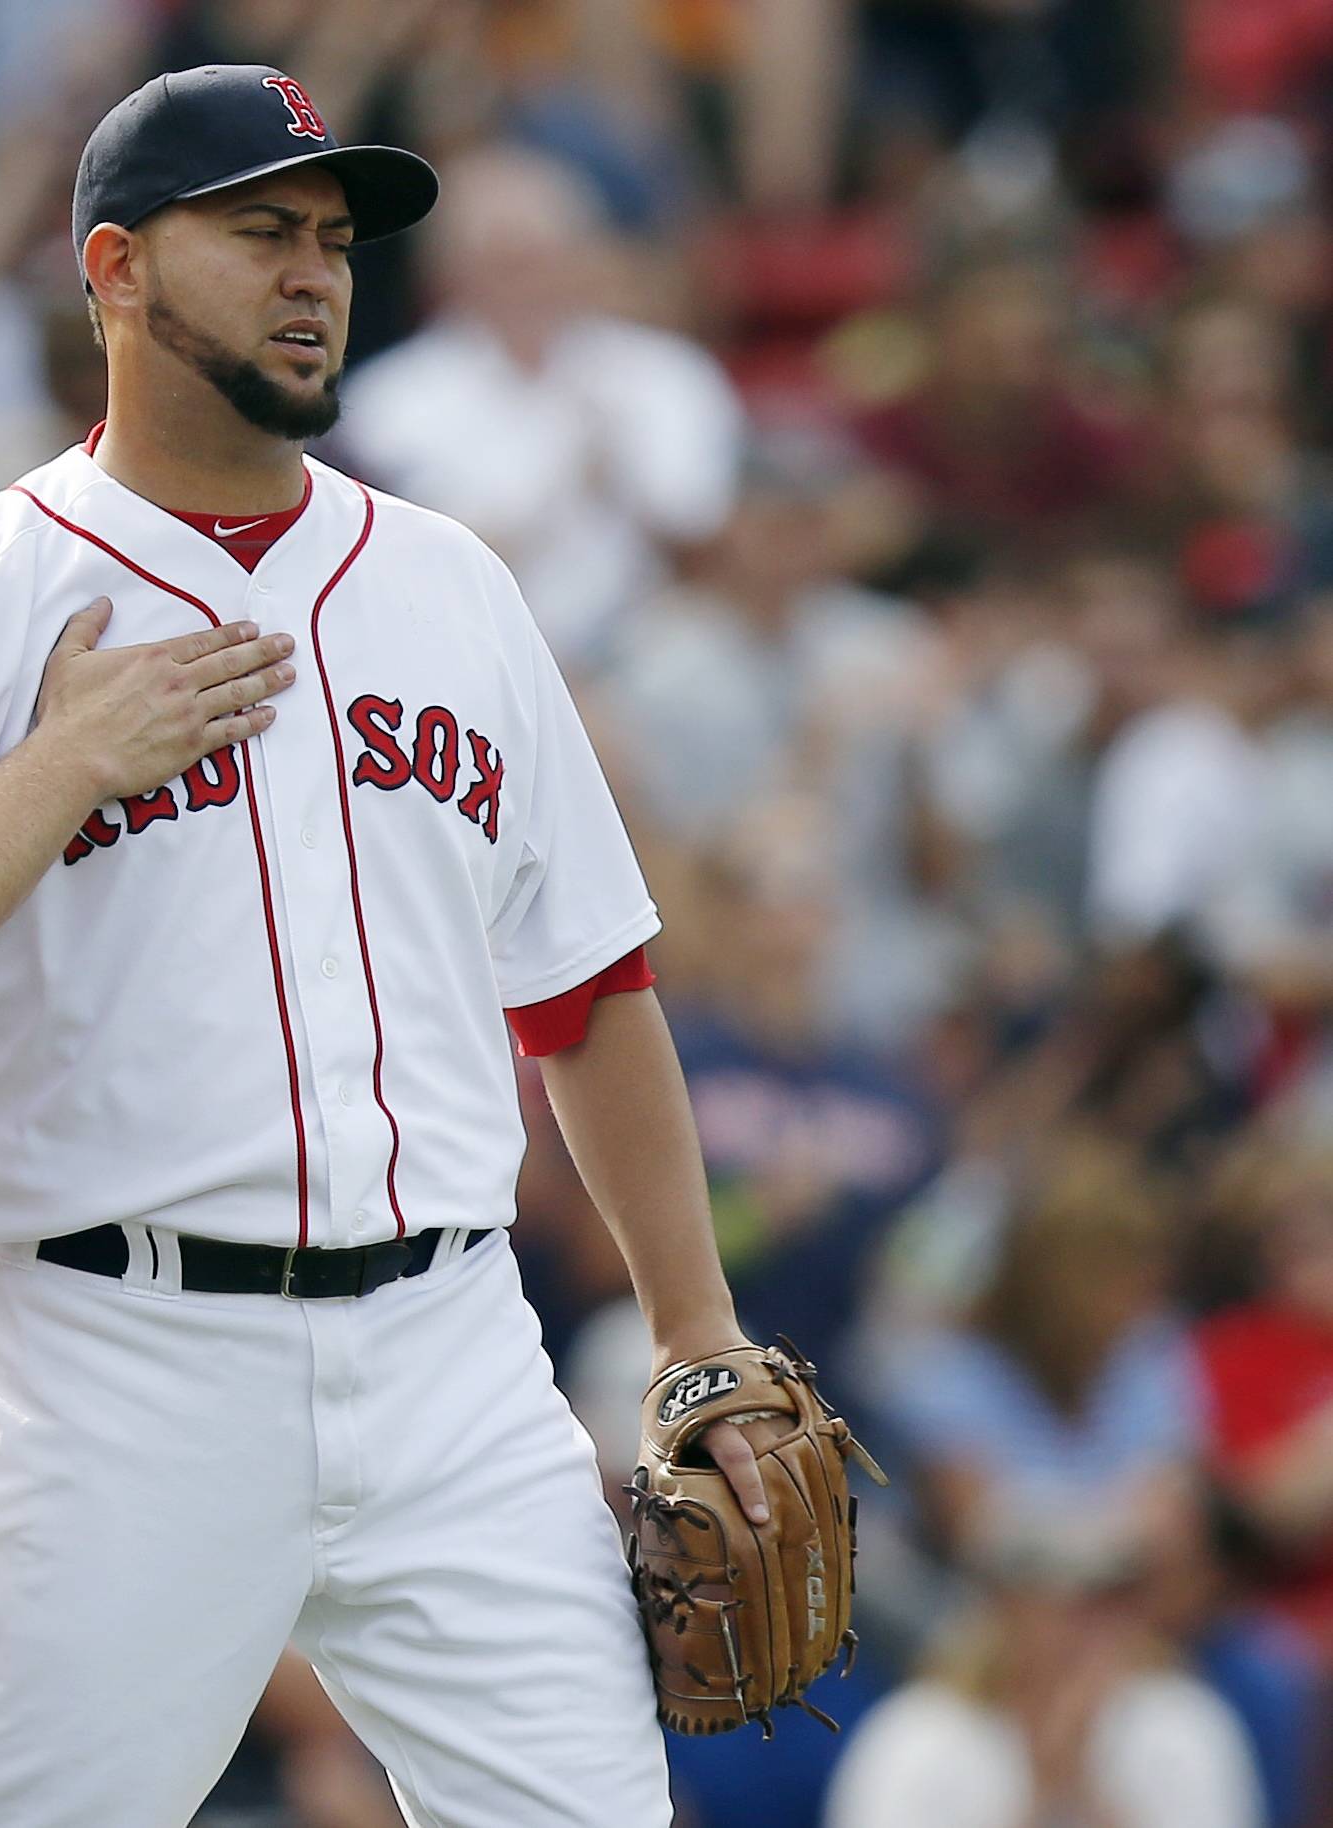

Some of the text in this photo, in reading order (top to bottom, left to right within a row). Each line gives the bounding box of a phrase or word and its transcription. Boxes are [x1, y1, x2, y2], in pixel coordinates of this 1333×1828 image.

[262, 77, 326, 142] B
[347, 694, 506, 845] SOX
[666, 1370, 737, 1421] TPX
[806, 1541, 827, 1641] TPX
